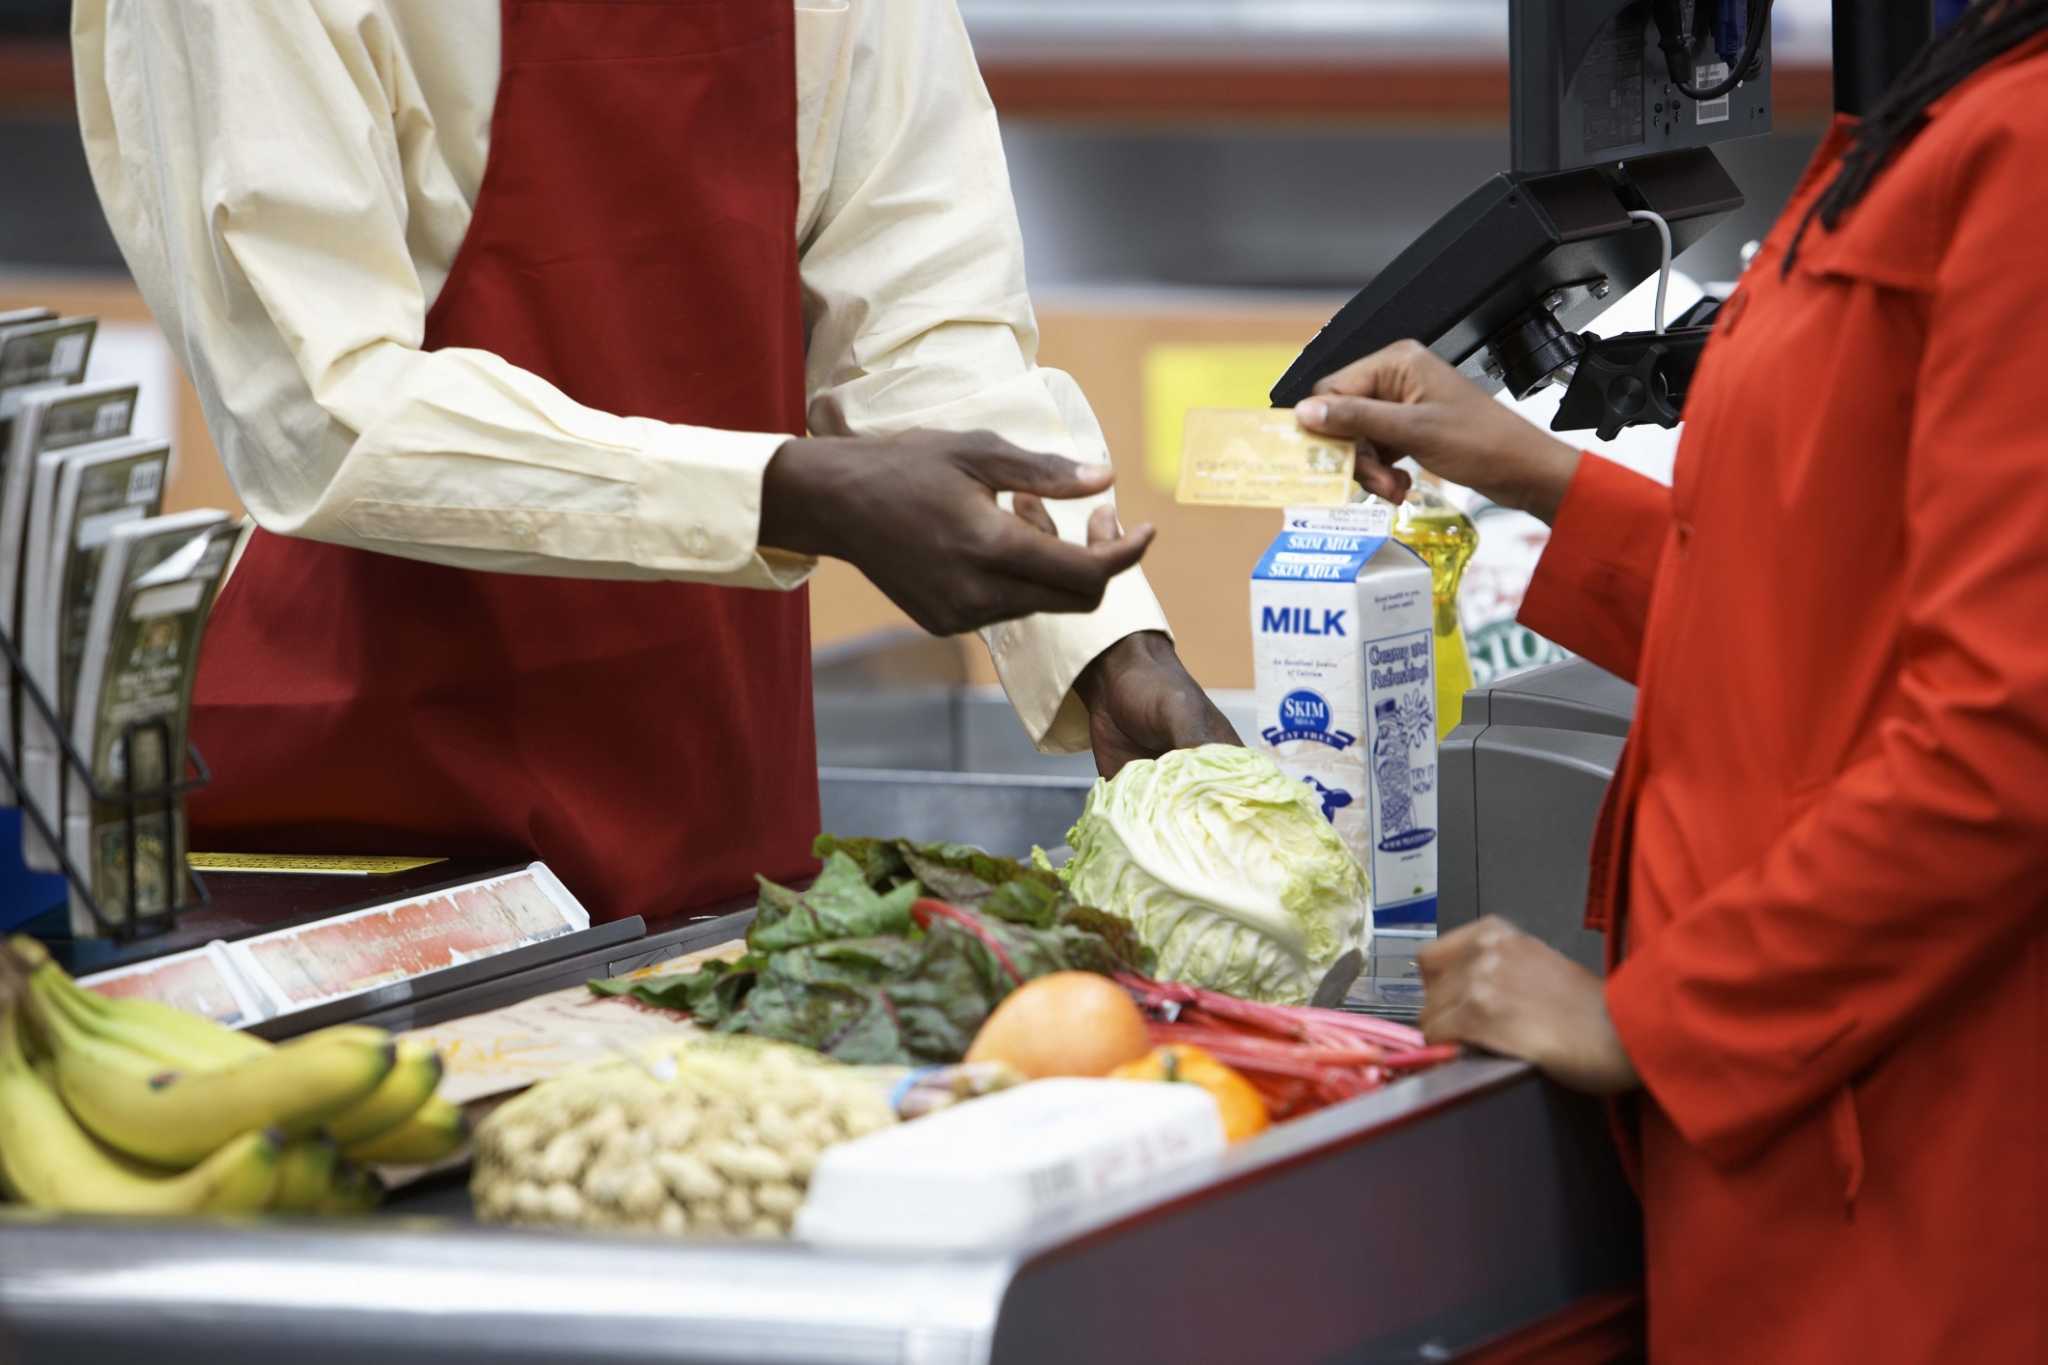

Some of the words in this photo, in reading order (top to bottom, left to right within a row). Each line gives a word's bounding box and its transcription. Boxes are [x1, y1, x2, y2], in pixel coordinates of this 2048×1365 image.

[1288, 534, 1324, 550] SKIM
[1325, 535, 1361, 551] MILK
[1268, 562, 1304, 577] SKIM
[1305, 564, 1341, 579] MILK
[1262, 606, 1347, 637] MILK
[1284, 697, 1325, 719] SKIM
